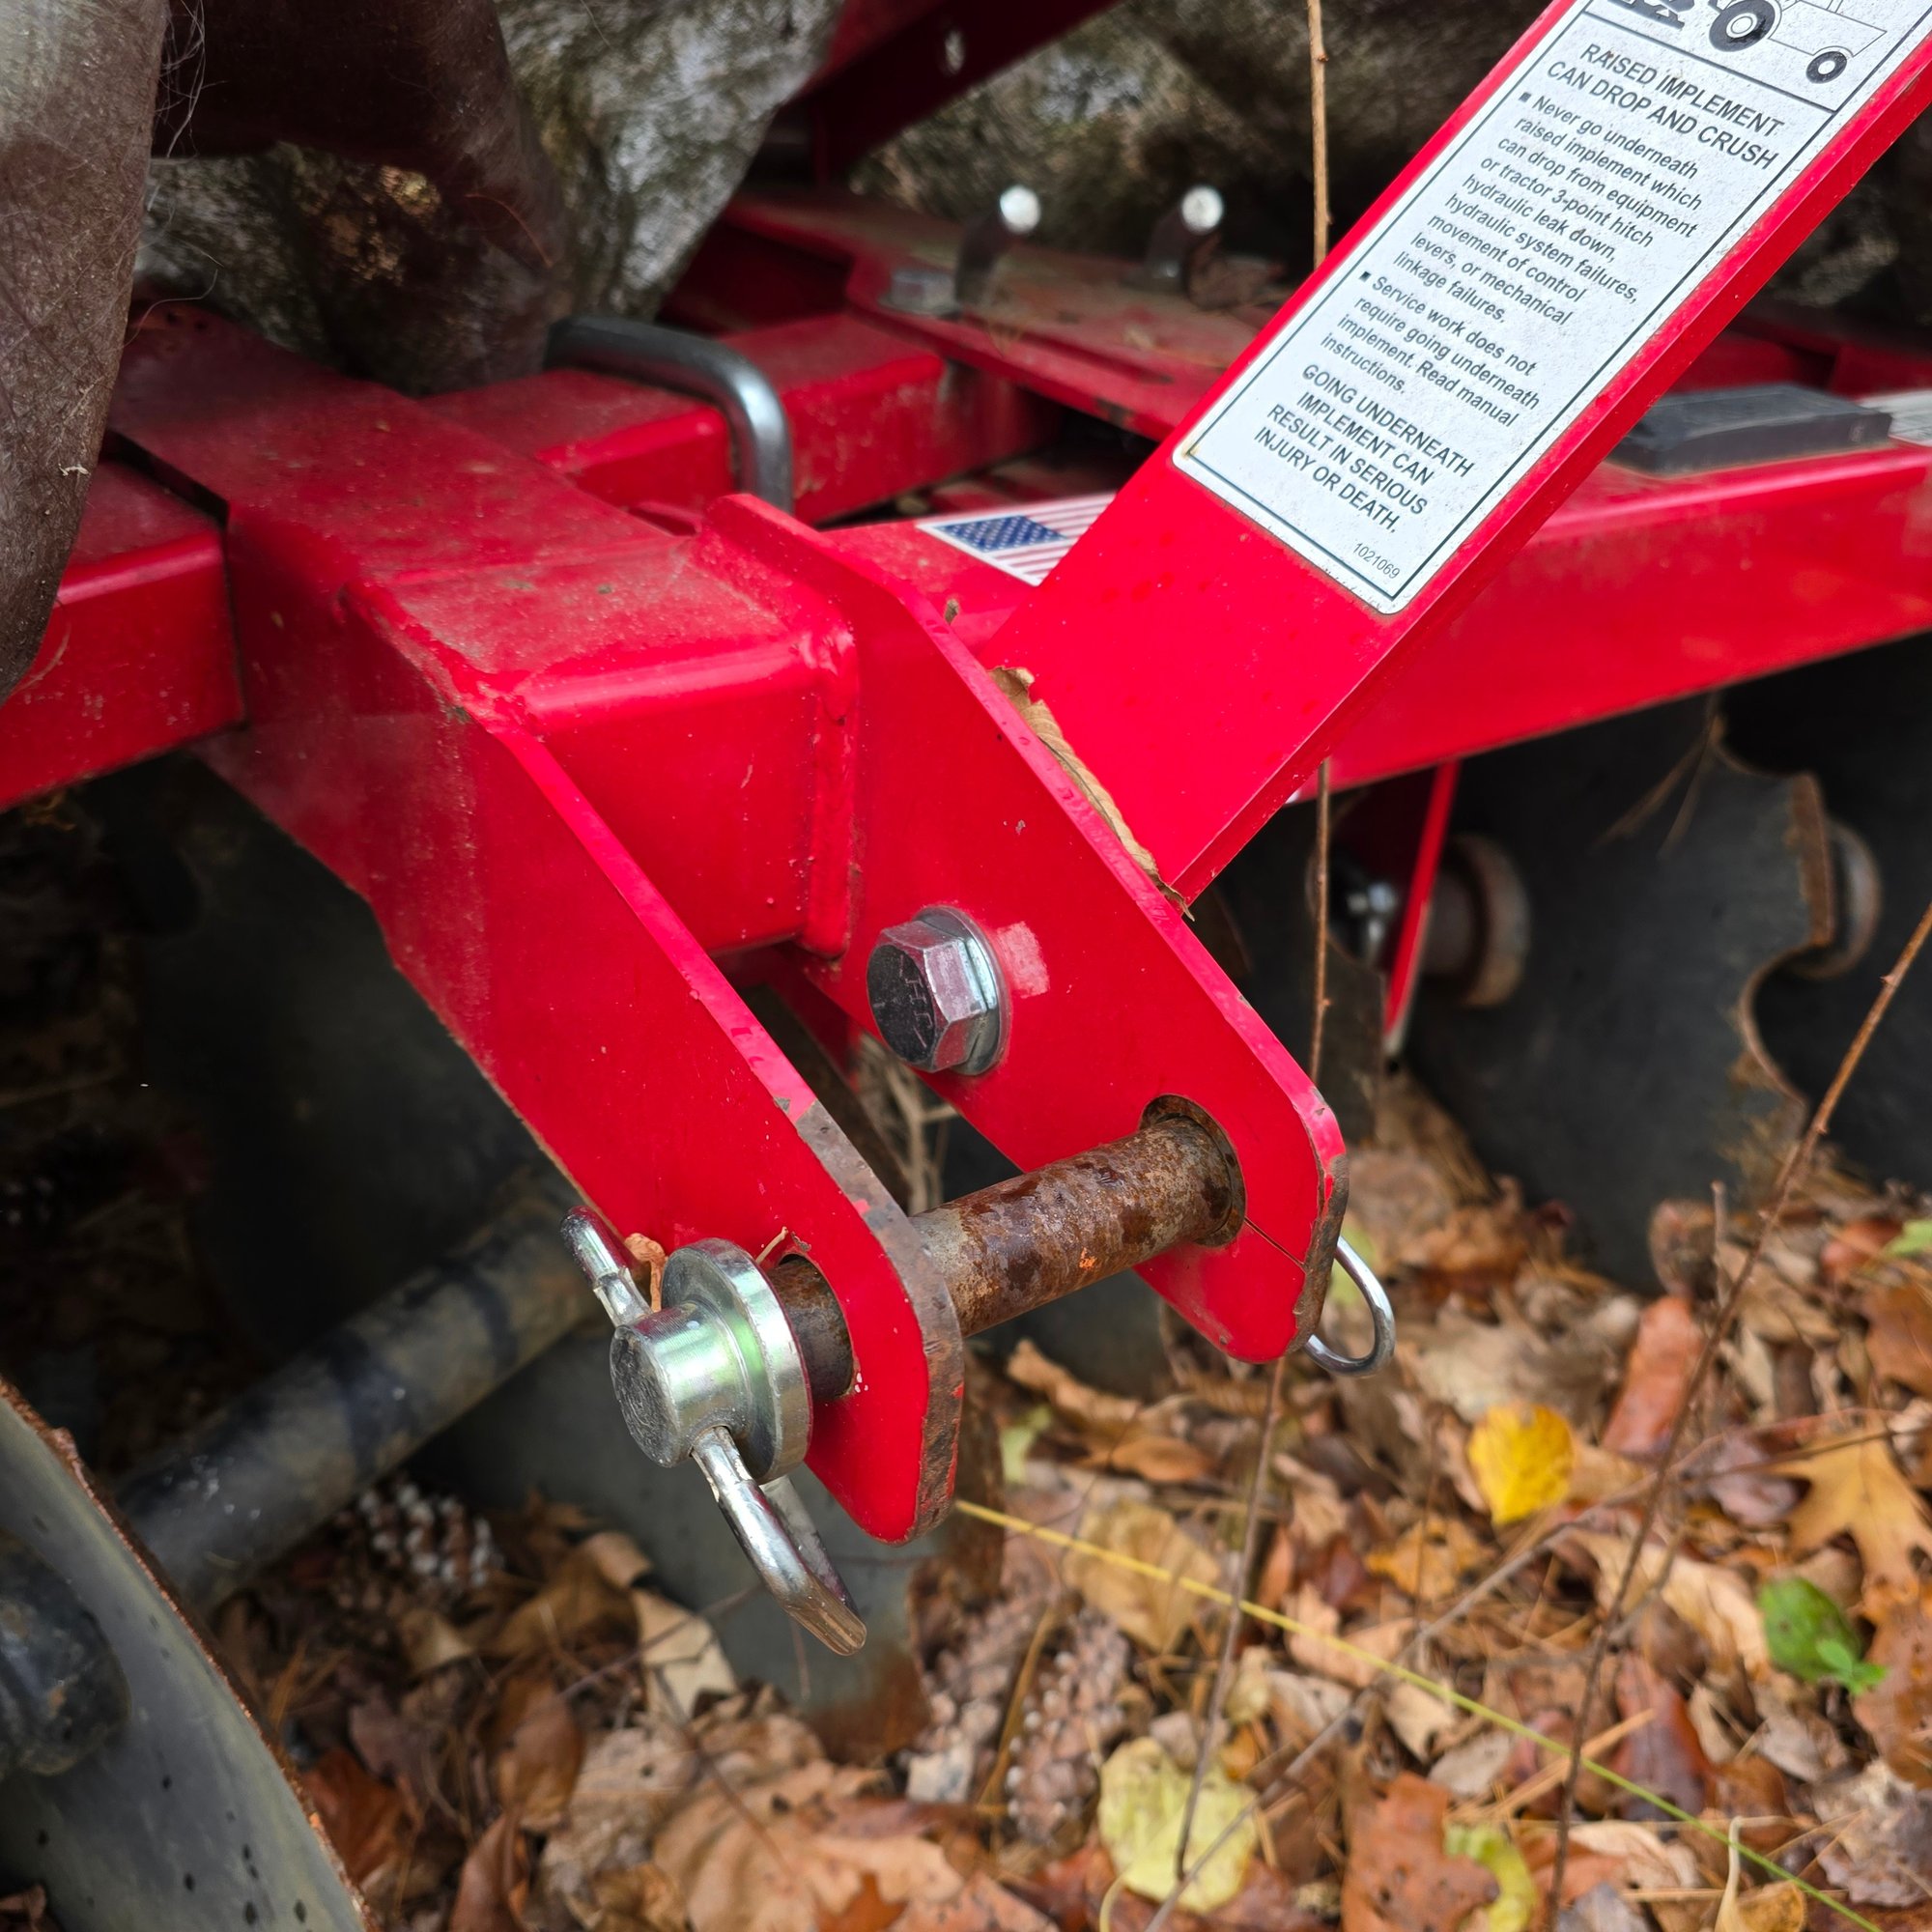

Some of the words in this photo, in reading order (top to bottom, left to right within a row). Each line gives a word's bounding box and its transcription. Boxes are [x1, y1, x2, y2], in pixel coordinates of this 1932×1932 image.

[1531, 95, 1581, 125] Never
[1576, 119, 1603, 135] go
[1603, 129, 1697, 179] underneath
[1547, 60, 1593, 90] CAN
[1588, 78, 1651, 112] DROP
[1645, 104, 1697, 134] AND
[1697, 125, 1778, 169] CRUSH
[1578, 43, 1658, 87] RAISED
[1654, 73, 1785, 136] IMPLEMENT
[1480, 157, 1500, 171] or
[1498, 163, 1552, 197] tractor
[1551, 188, 1612, 226] 3-point
[1607, 215, 1653, 247] hitch
[1497, 137, 1526, 157] can
[1527, 150, 1565, 177] drop
[1565, 166, 1605, 195] from
[1605, 188, 1698, 238] equipment
[1514, 118, 1568, 147] raised
[1563, 137, 1652, 186] implement
[1650, 179, 1701, 211] which
[1426, 214, 1509, 262] movement
[1506, 256, 1530, 271] of
[1524, 267, 1588, 302] control
[1444, 192, 1515, 237] hydraulic
[1514, 232, 1574, 268] system
[1573, 258, 1637, 304] failures,
[1462, 173, 1533, 216] hydraulic
[1532, 208, 1569, 236] leak
[1568, 227, 1615, 263] down,
[1372, 275, 1426, 314] Service
[1426, 308, 1465, 337] work
[1464, 330, 1505, 358] does
[1504, 354, 1537, 376] not
[1392, 250, 1446, 288] linkage
[1446, 280, 1505, 323] failures.
[1409, 231, 1456, 269] levers,
[1461, 262, 1481, 276] or
[1478, 270, 1574, 325] mechanical
[1320, 331, 1405, 394] instructions.
[1337, 313, 1415, 368] implement.
[1415, 359, 1461, 392] Read
[1456, 386, 1520, 427] manual
[1353, 298, 1406, 331] require
[1403, 327, 1451, 360] going
[1450, 353, 1539, 410] underneath
[1266, 403, 1334, 451] RESULT
[1327, 443, 1352, 465] IN
[1349, 457, 1428, 514] SERIOUS
[1296, 390, 1396, 458] IMPLEMENT
[1392, 452, 1435, 486] CAN
[1302, 363, 1357, 404] GOING
[1355, 395, 1475, 477] UNDERNEATH
[1253, 426, 1317, 471] INJURY
[1312, 466, 1341, 492] OR
[1337, 482, 1400, 533] DEATH.
[1352, 542, 1400, 574] 1021069
